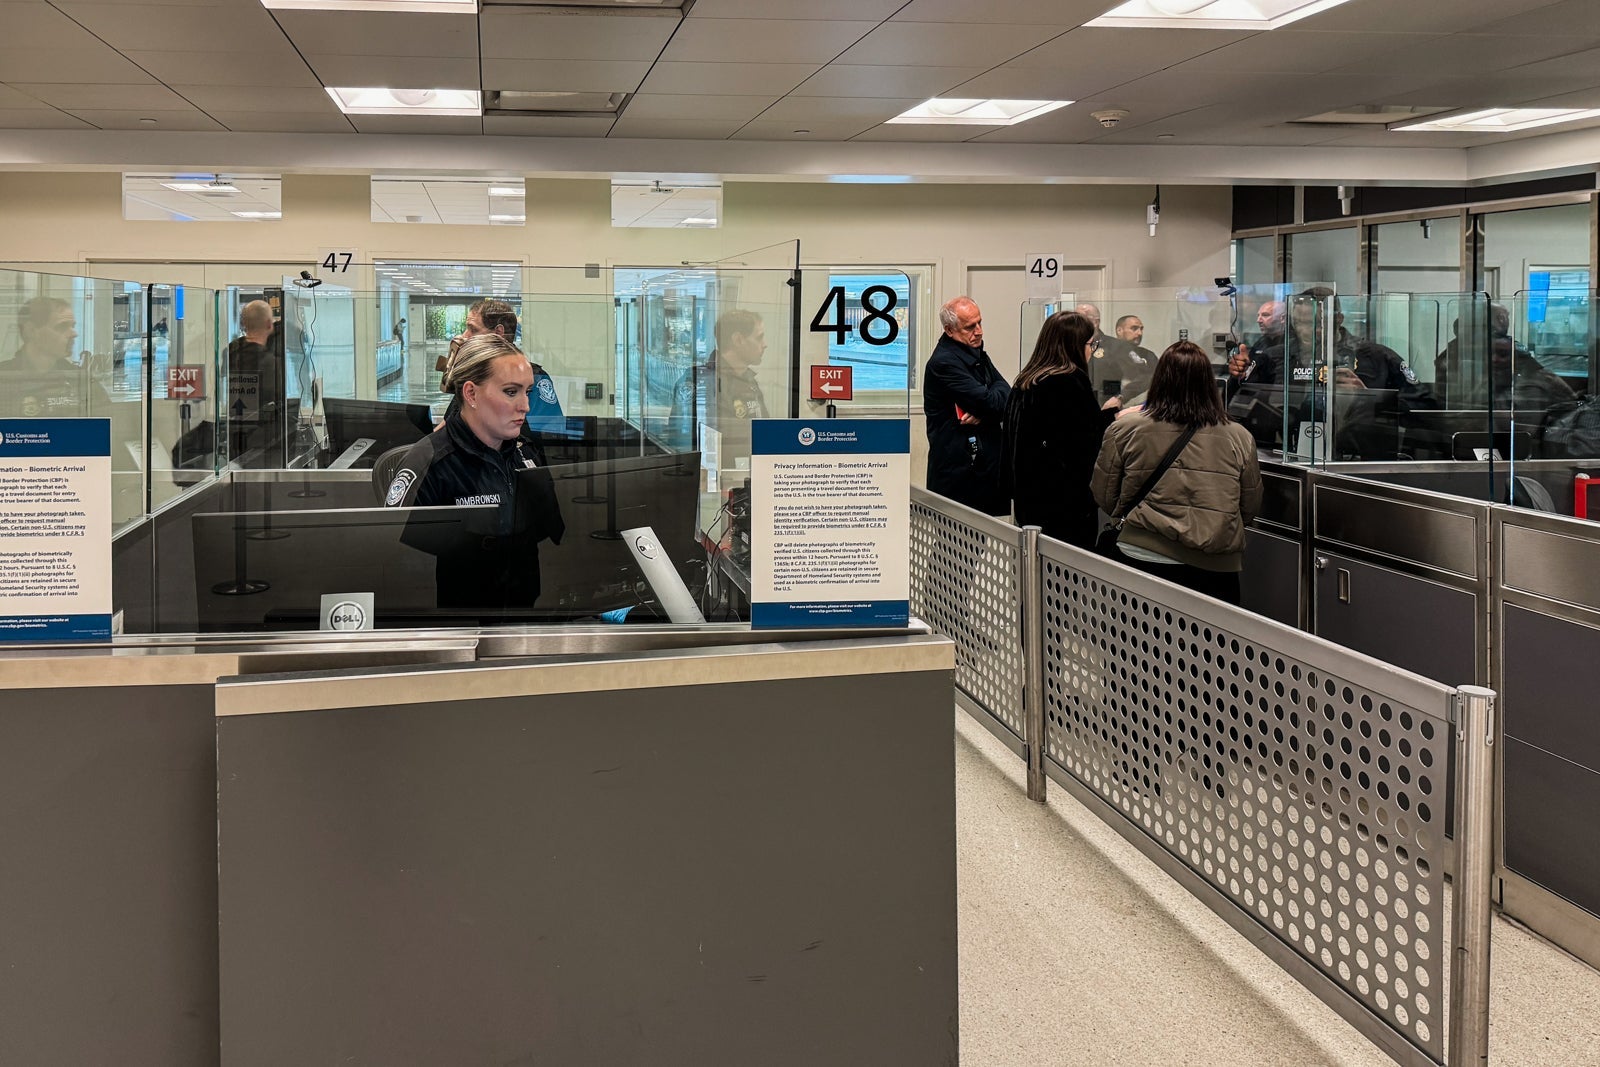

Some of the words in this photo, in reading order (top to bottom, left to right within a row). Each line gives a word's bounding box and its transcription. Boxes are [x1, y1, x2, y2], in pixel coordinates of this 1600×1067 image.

[322, 252, 353, 273] 47
[1030, 257, 1058, 278] 49
[810, 285, 899, 346] 48
[169, 368, 198, 381] EXIT
[819, 369, 843, 379] EXIT
[455, 494, 501, 506] DOMBROWSKI
[334, 614, 360, 624] DELL
